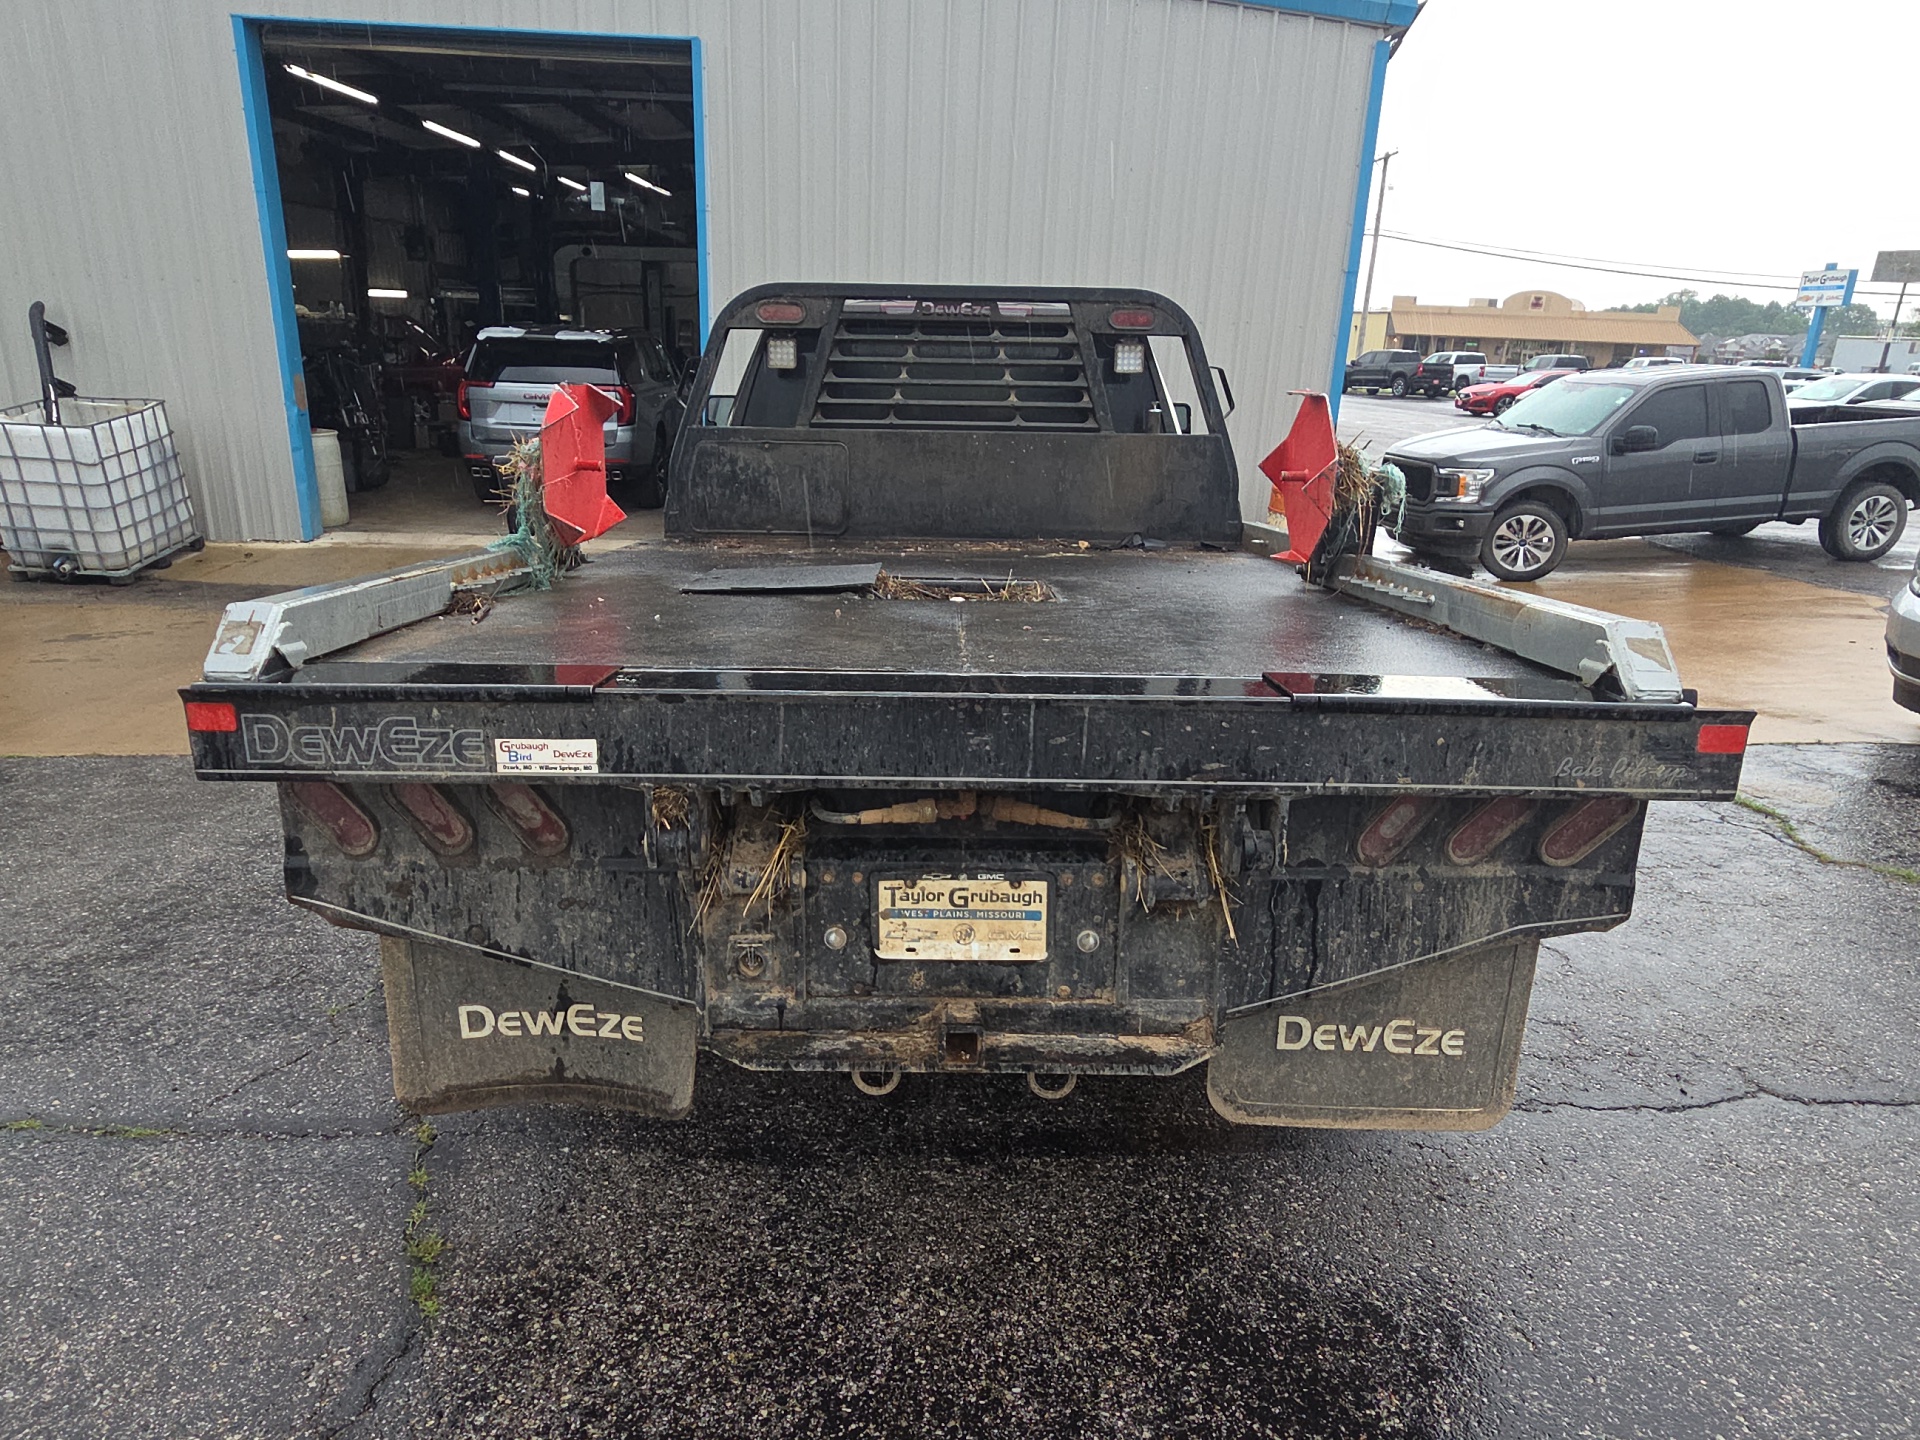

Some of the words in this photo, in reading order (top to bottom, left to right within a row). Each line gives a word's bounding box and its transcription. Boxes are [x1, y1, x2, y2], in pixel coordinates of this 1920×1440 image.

[240, 713, 487, 767] DewEze
[499, 740, 549, 753] Grubaugh
[508, 750, 533, 762] Bird
[884, 886, 945, 908] Taylor
[949, 887, 1043, 909] Grubaugh
[933, 911, 973, 919] PLAINS,
[976, 911, 1026, 919] MISSOURI
[988, 930, 1042, 941] GMC
[458, 1003, 644, 1042] DewEze
[1276, 1015, 1466, 1056] DewEze
